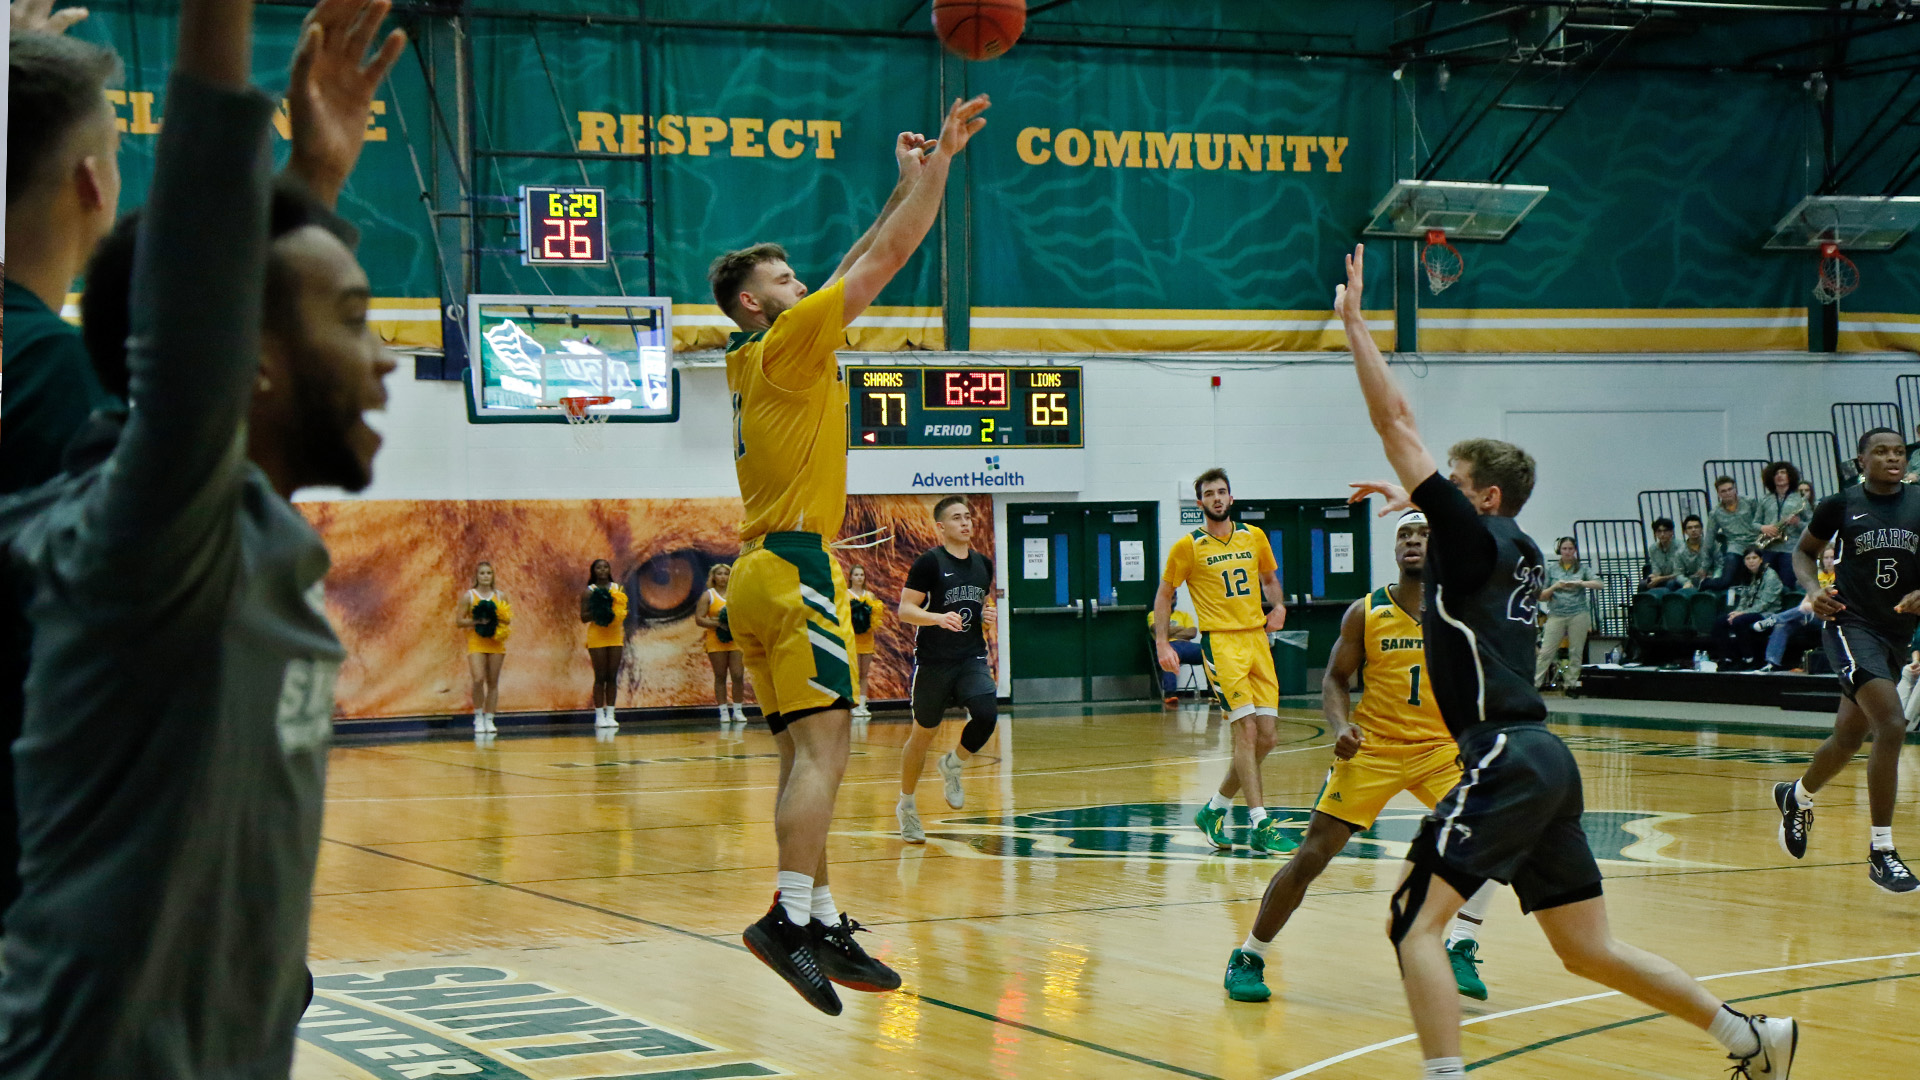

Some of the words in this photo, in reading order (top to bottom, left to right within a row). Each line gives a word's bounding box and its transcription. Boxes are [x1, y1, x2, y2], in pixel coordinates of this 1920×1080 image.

[578, 111, 842, 159] RESPECT
[1016, 127, 1349, 172] COMMUNITY
[548, 193, 598, 217] 6:29
[543, 219, 592, 259] 26
[863, 373, 903, 387] SHARKS
[945, 372, 1006, 405] 6:29
[1030, 372, 1061, 387] LIONS
[869, 393, 907, 426] 77
[1032, 393, 1068, 426] 65
[924, 424, 972, 437] PERIOD
[981, 418, 995, 443] 2
[912, 472, 1024, 487] AdventHealth
[1855, 528, 1919, 555] SHARKS
[1206, 554, 1233, 565] SAINT
[1236, 551, 1252, 560] LEO
[1221, 568, 1250, 598] 12
[1875, 558, 1898, 589] 5
[958, 607, 973, 632] 2
[1381, 638, 1424, 651] SAINT
[1408, 664, 1421, 706] 1
